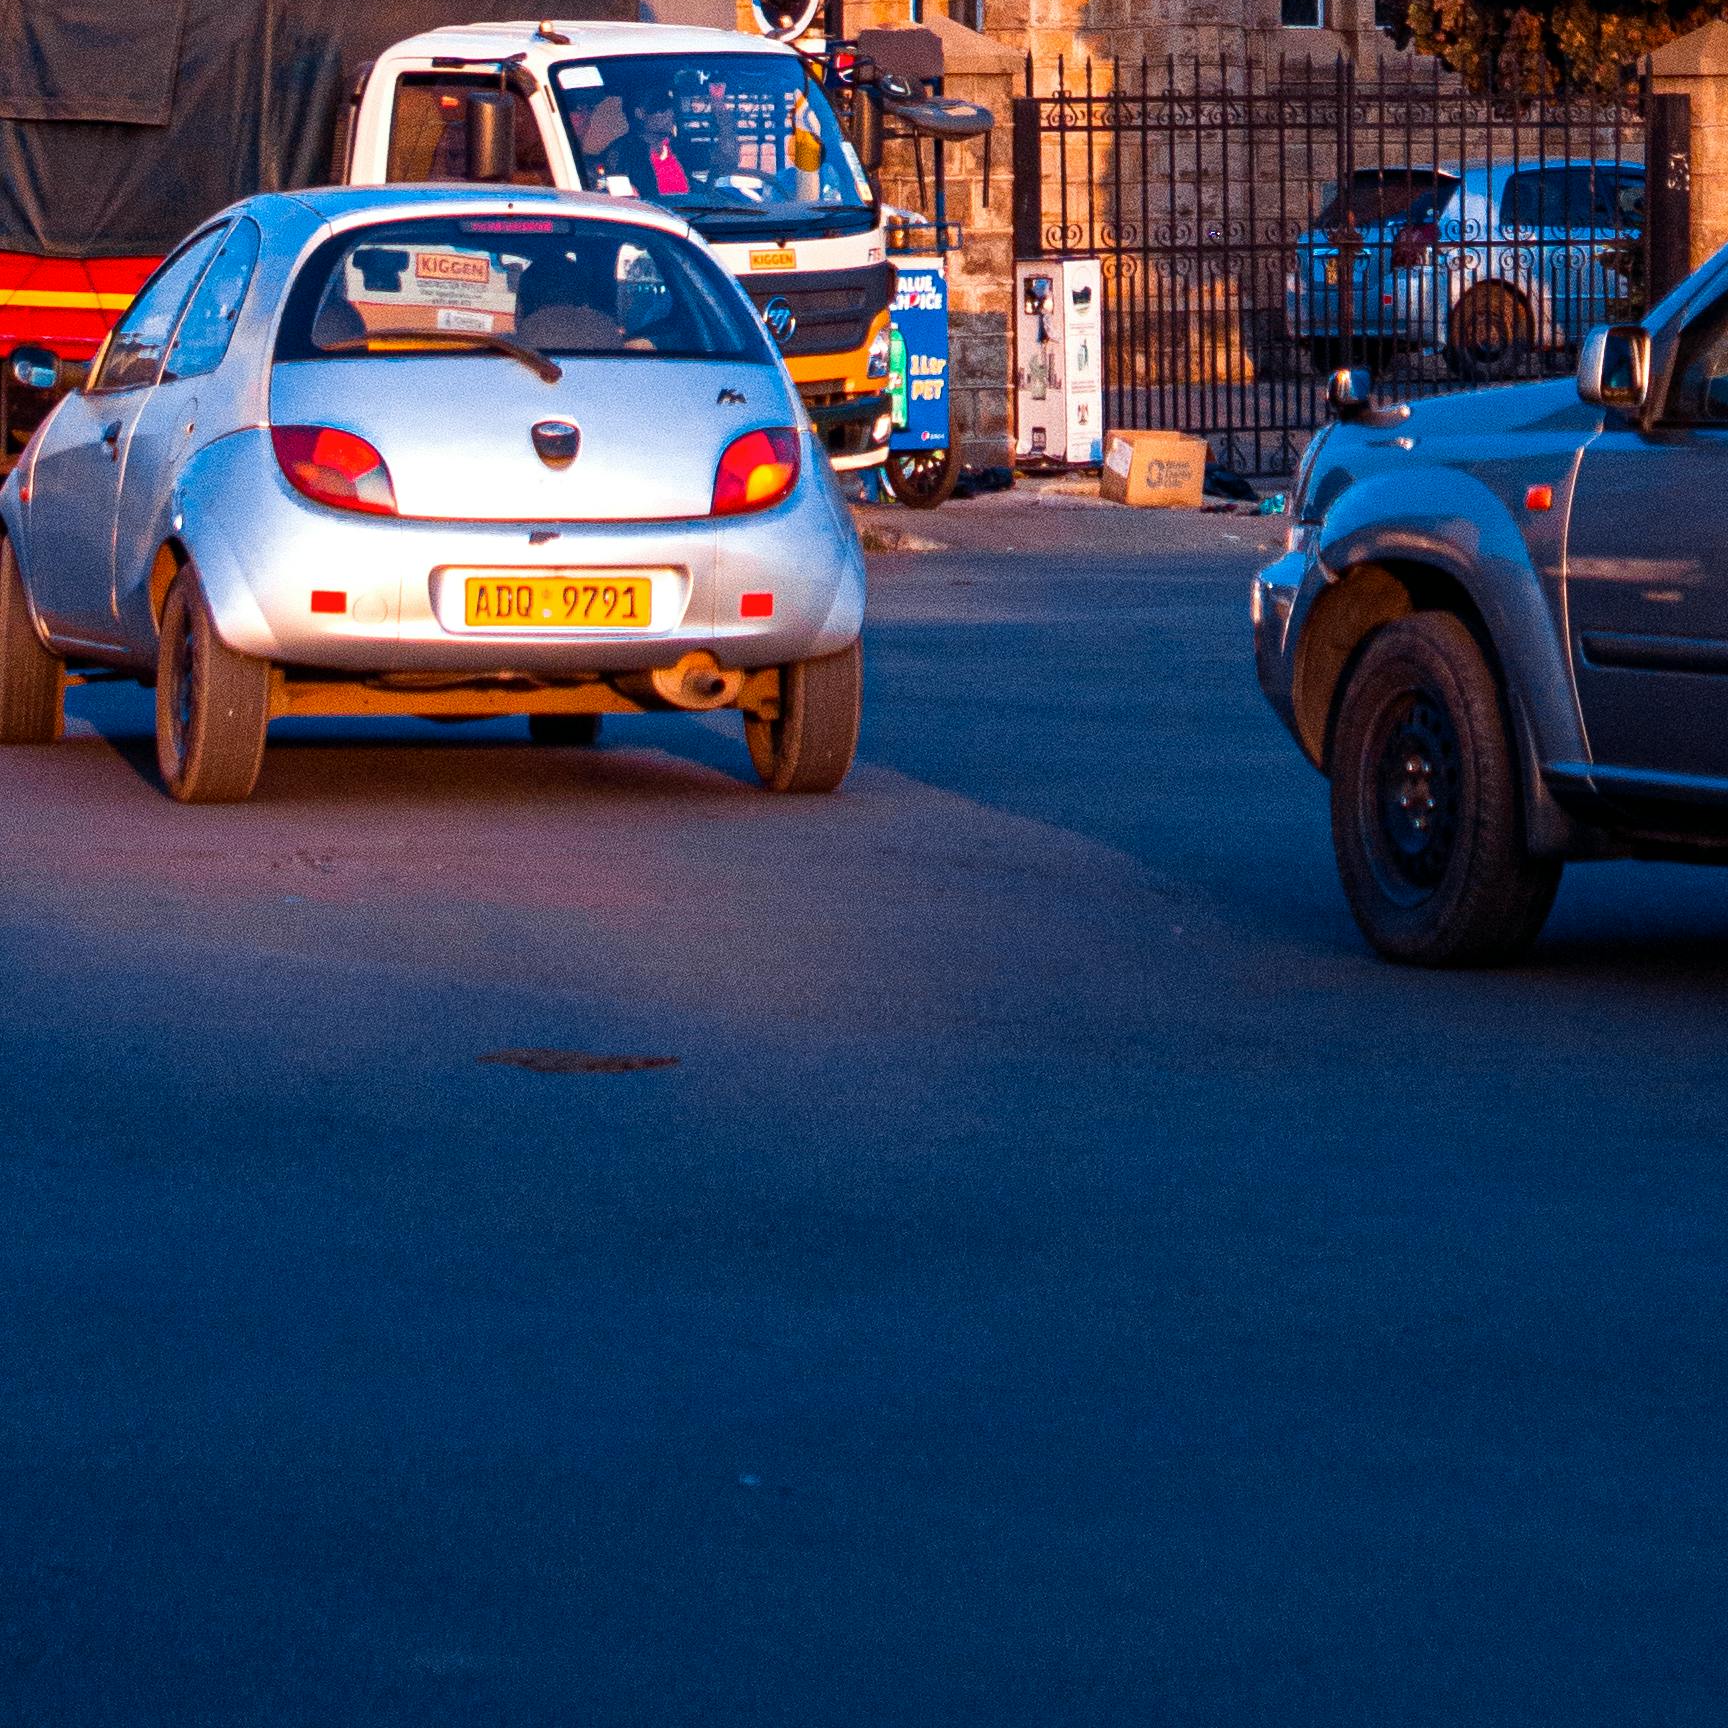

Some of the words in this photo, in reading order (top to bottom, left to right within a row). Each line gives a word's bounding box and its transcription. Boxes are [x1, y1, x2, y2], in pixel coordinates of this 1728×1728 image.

[421, 257, 485, 277] KIGGEN
[752, 254, 794, 266] KIGGEN
[897, 276, 937, 294] ALUE,
[910, 379, 945, 401] PET
[475, 585, 533, 619] ADQ
[562, 585, 638, 619] 9791
